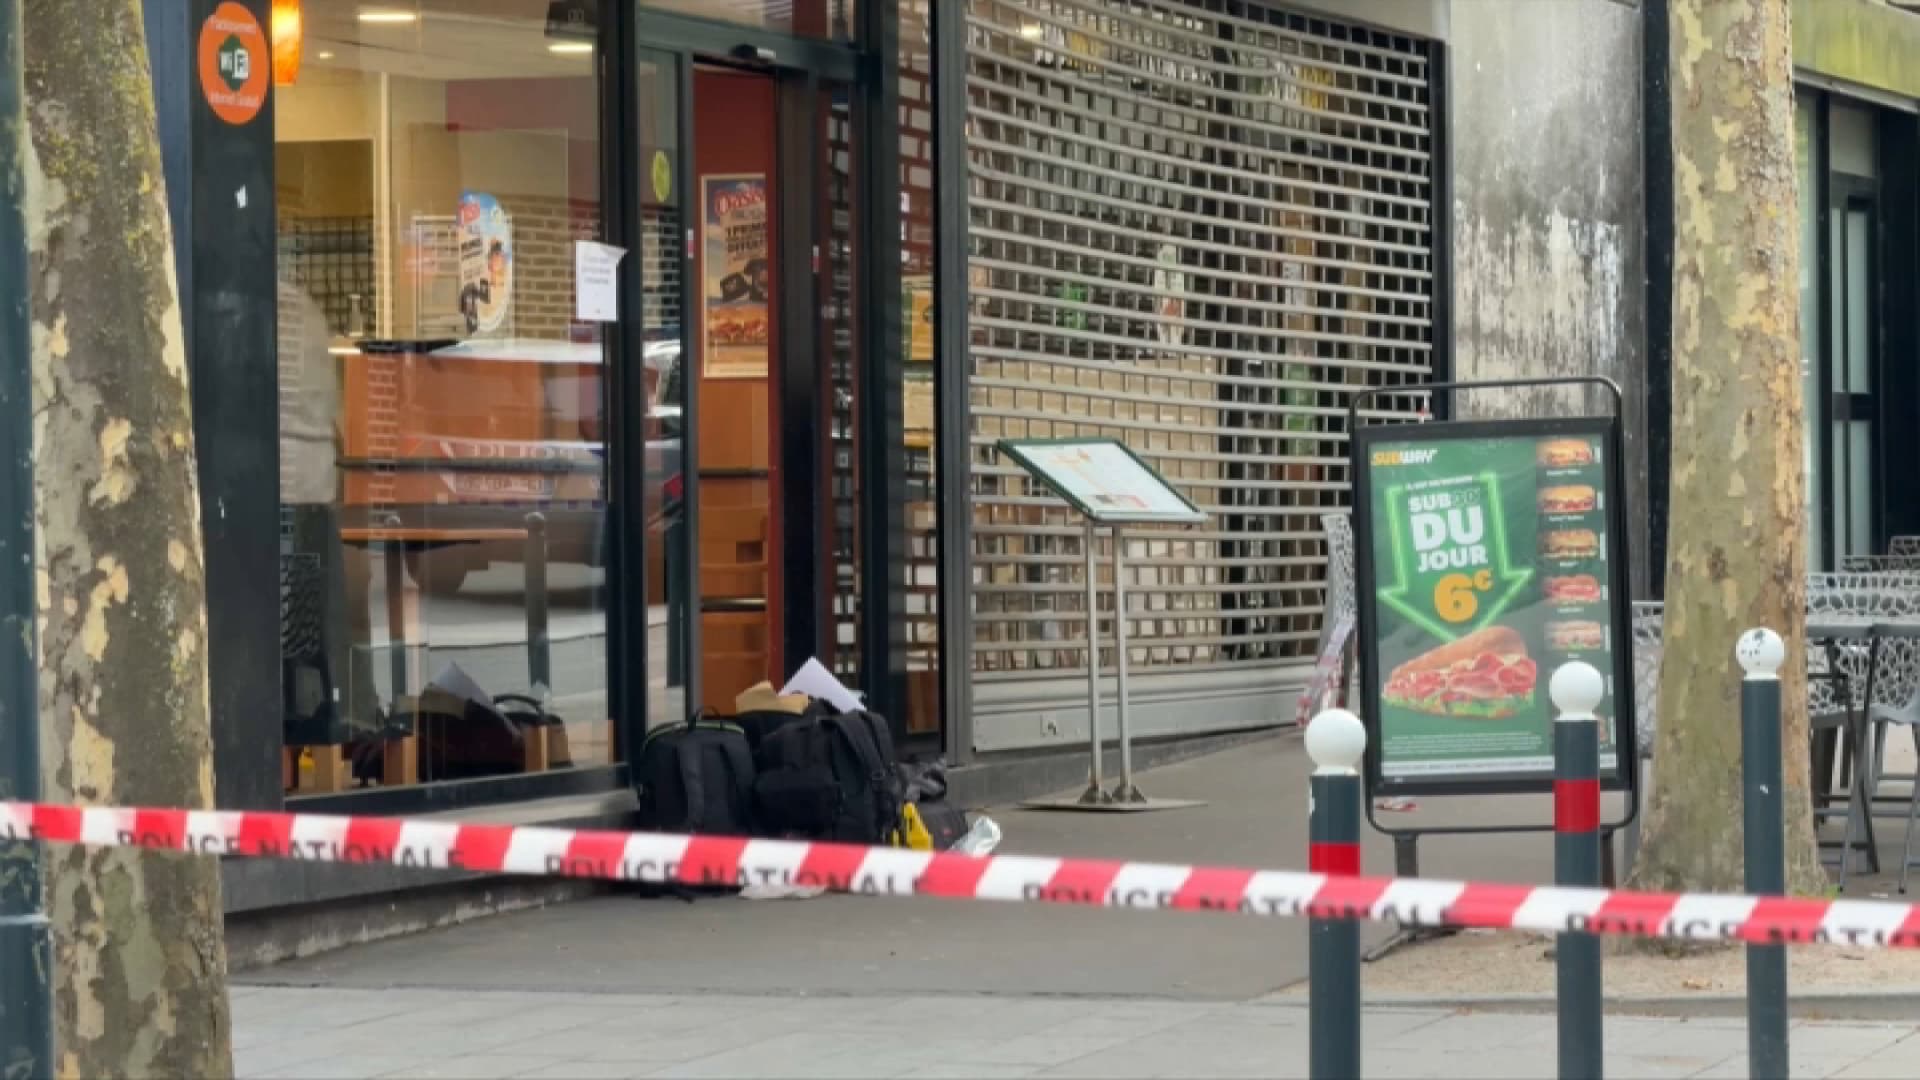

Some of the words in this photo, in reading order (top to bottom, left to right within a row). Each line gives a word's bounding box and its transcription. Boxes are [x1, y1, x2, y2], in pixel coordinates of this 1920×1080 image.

[1370, 448, 1438, 466] SUBWAY
[1410, 505, 1483, 551] DU
[1418, 544, 1488, 573] JOUR
[117, 829, 241, 854] POLICE
[544, 854, 684, 882] POLICE
